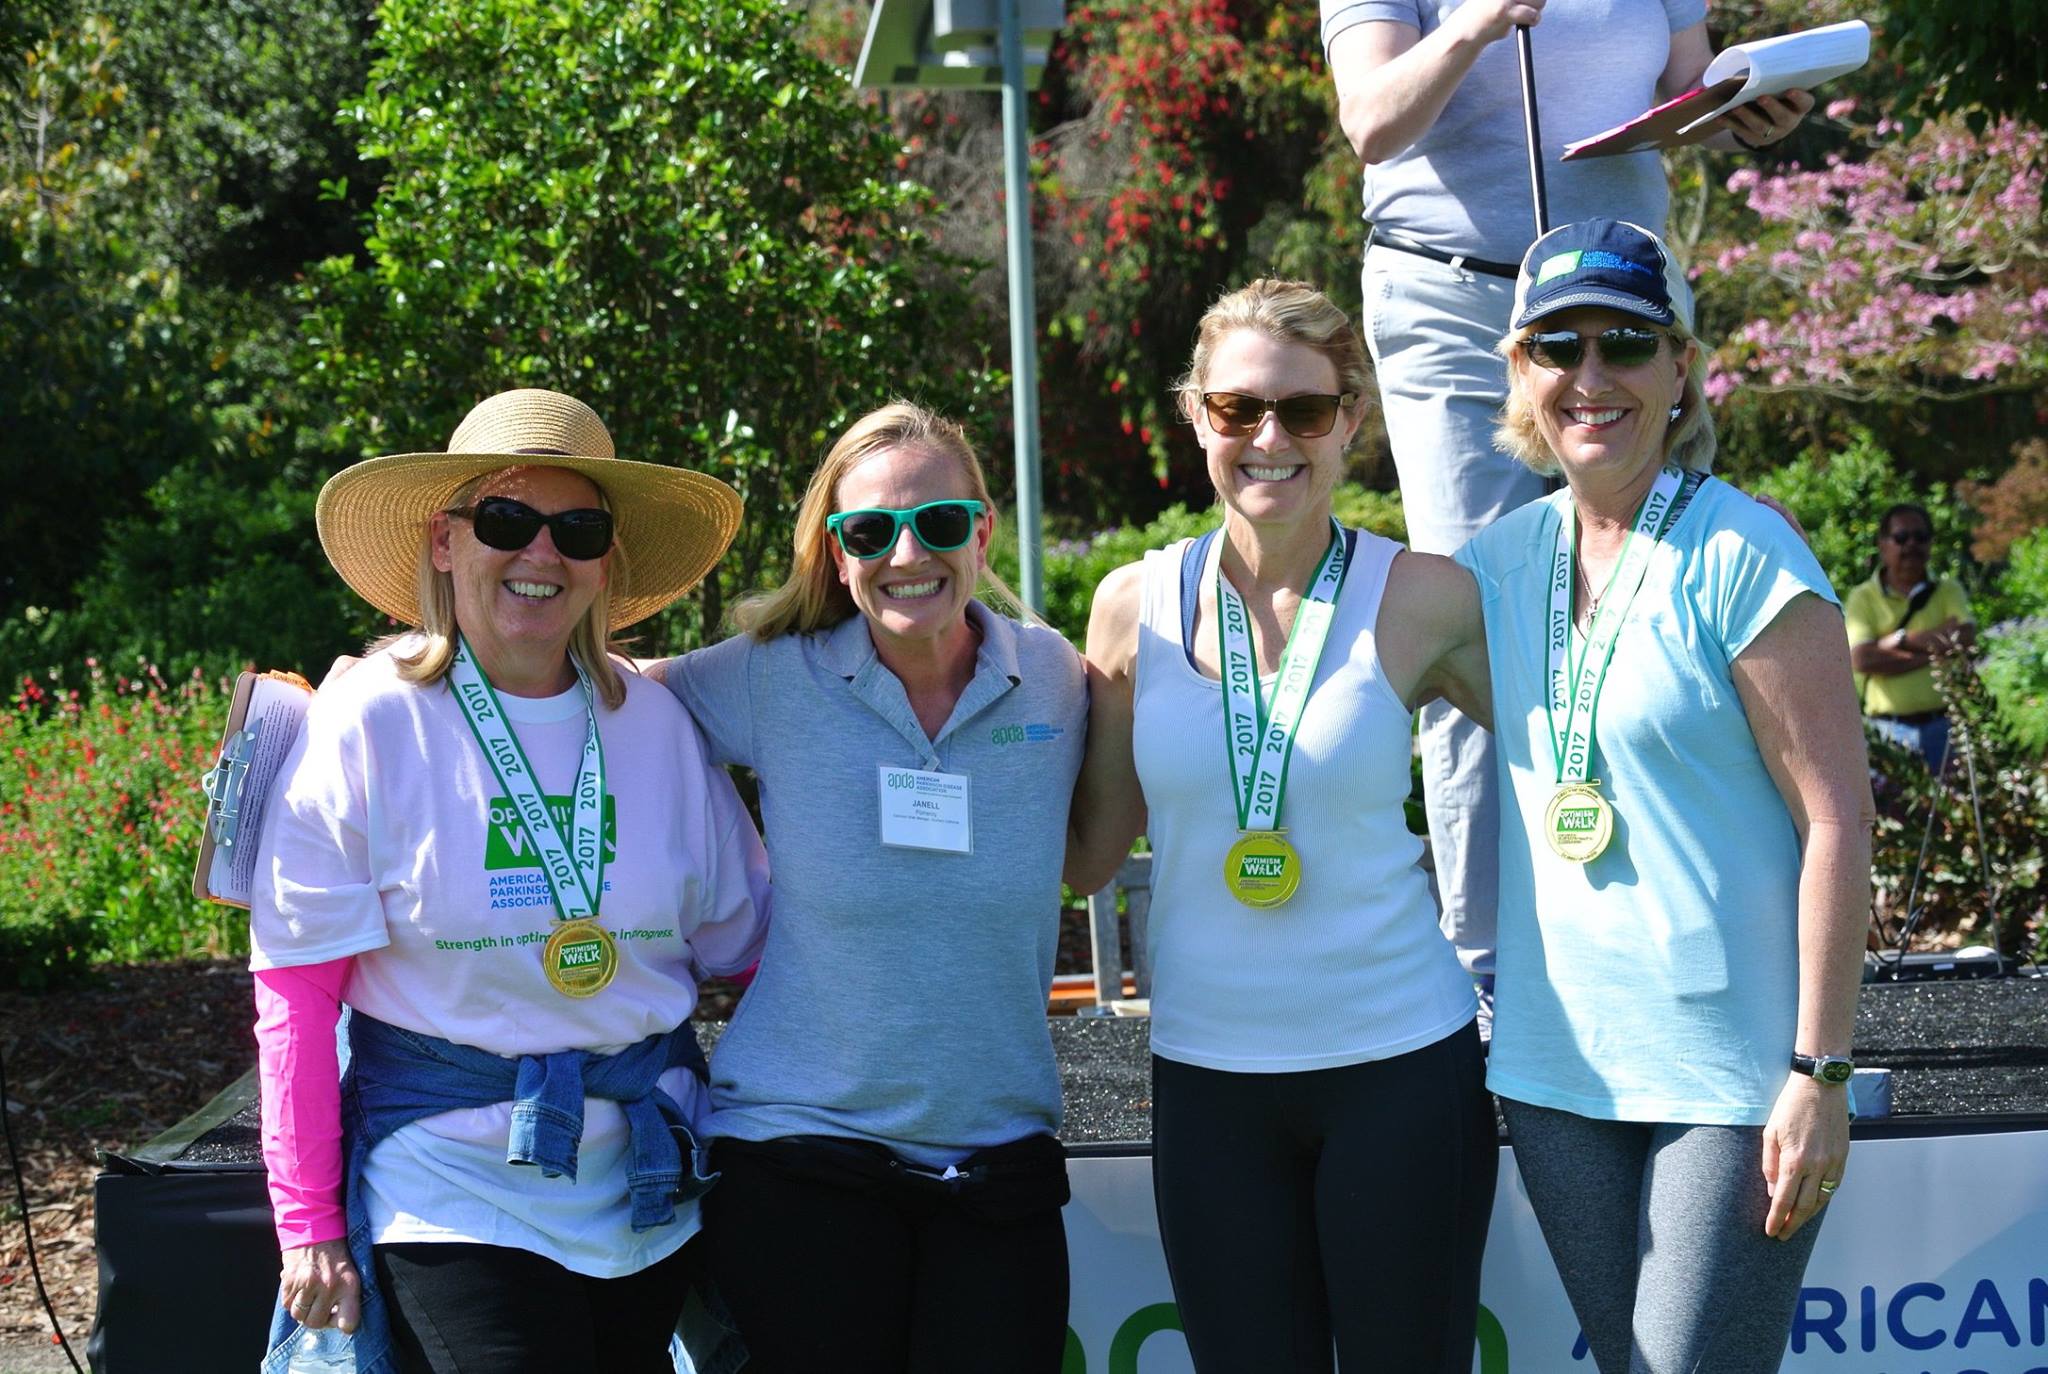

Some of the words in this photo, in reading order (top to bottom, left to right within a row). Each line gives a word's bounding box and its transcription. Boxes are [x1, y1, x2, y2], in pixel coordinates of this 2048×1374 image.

[1641, 491, 1668, 534] 2017
[1555, 552, 1568, 592] 2017
[1226, 591, 1244, 634] 2017
[1553, 609, 1565, 651] 2017
[1231, 651, 1249, 695] 2017
[1285, 655, 1308, 694] 2017
[1552, 669, 1567, 712] 2017
[1578, 668, 1597, 713] 2017
[461, 683, 495, 722] 2017
[1235, 712, 1255, 756] 2017
[1266, 710, 1289, 754] 2017
[489, 738, 522, 777] 2017
[1568, 731, 1586, 778] 2017
[580, 770, 596, 810] 2017
[887, 772, 915, 790] apda
[1254, 770, 1277, 817] 2017
[517, 793, 550, 833] 2017
[912, 800, 940, 810] JANELL
[578, 826, 596, 871] 2017
[1242, 857, 1280, 865] OPTIMISM
[545, 848, 576, 891] 2017
[490, 884, 552, 898] PARKINSO
[491, 896, 553, 910] ASSOCIATI
[435, 937, 497, 952] Strength
[500, 935, 514, 947] in
[517, 931, 551, 947] optim
[560, 944, 598, 955] OPTIMISM
[620, 929, 631, 940] in
[1789, 1277, 2048, 1354] RICA
